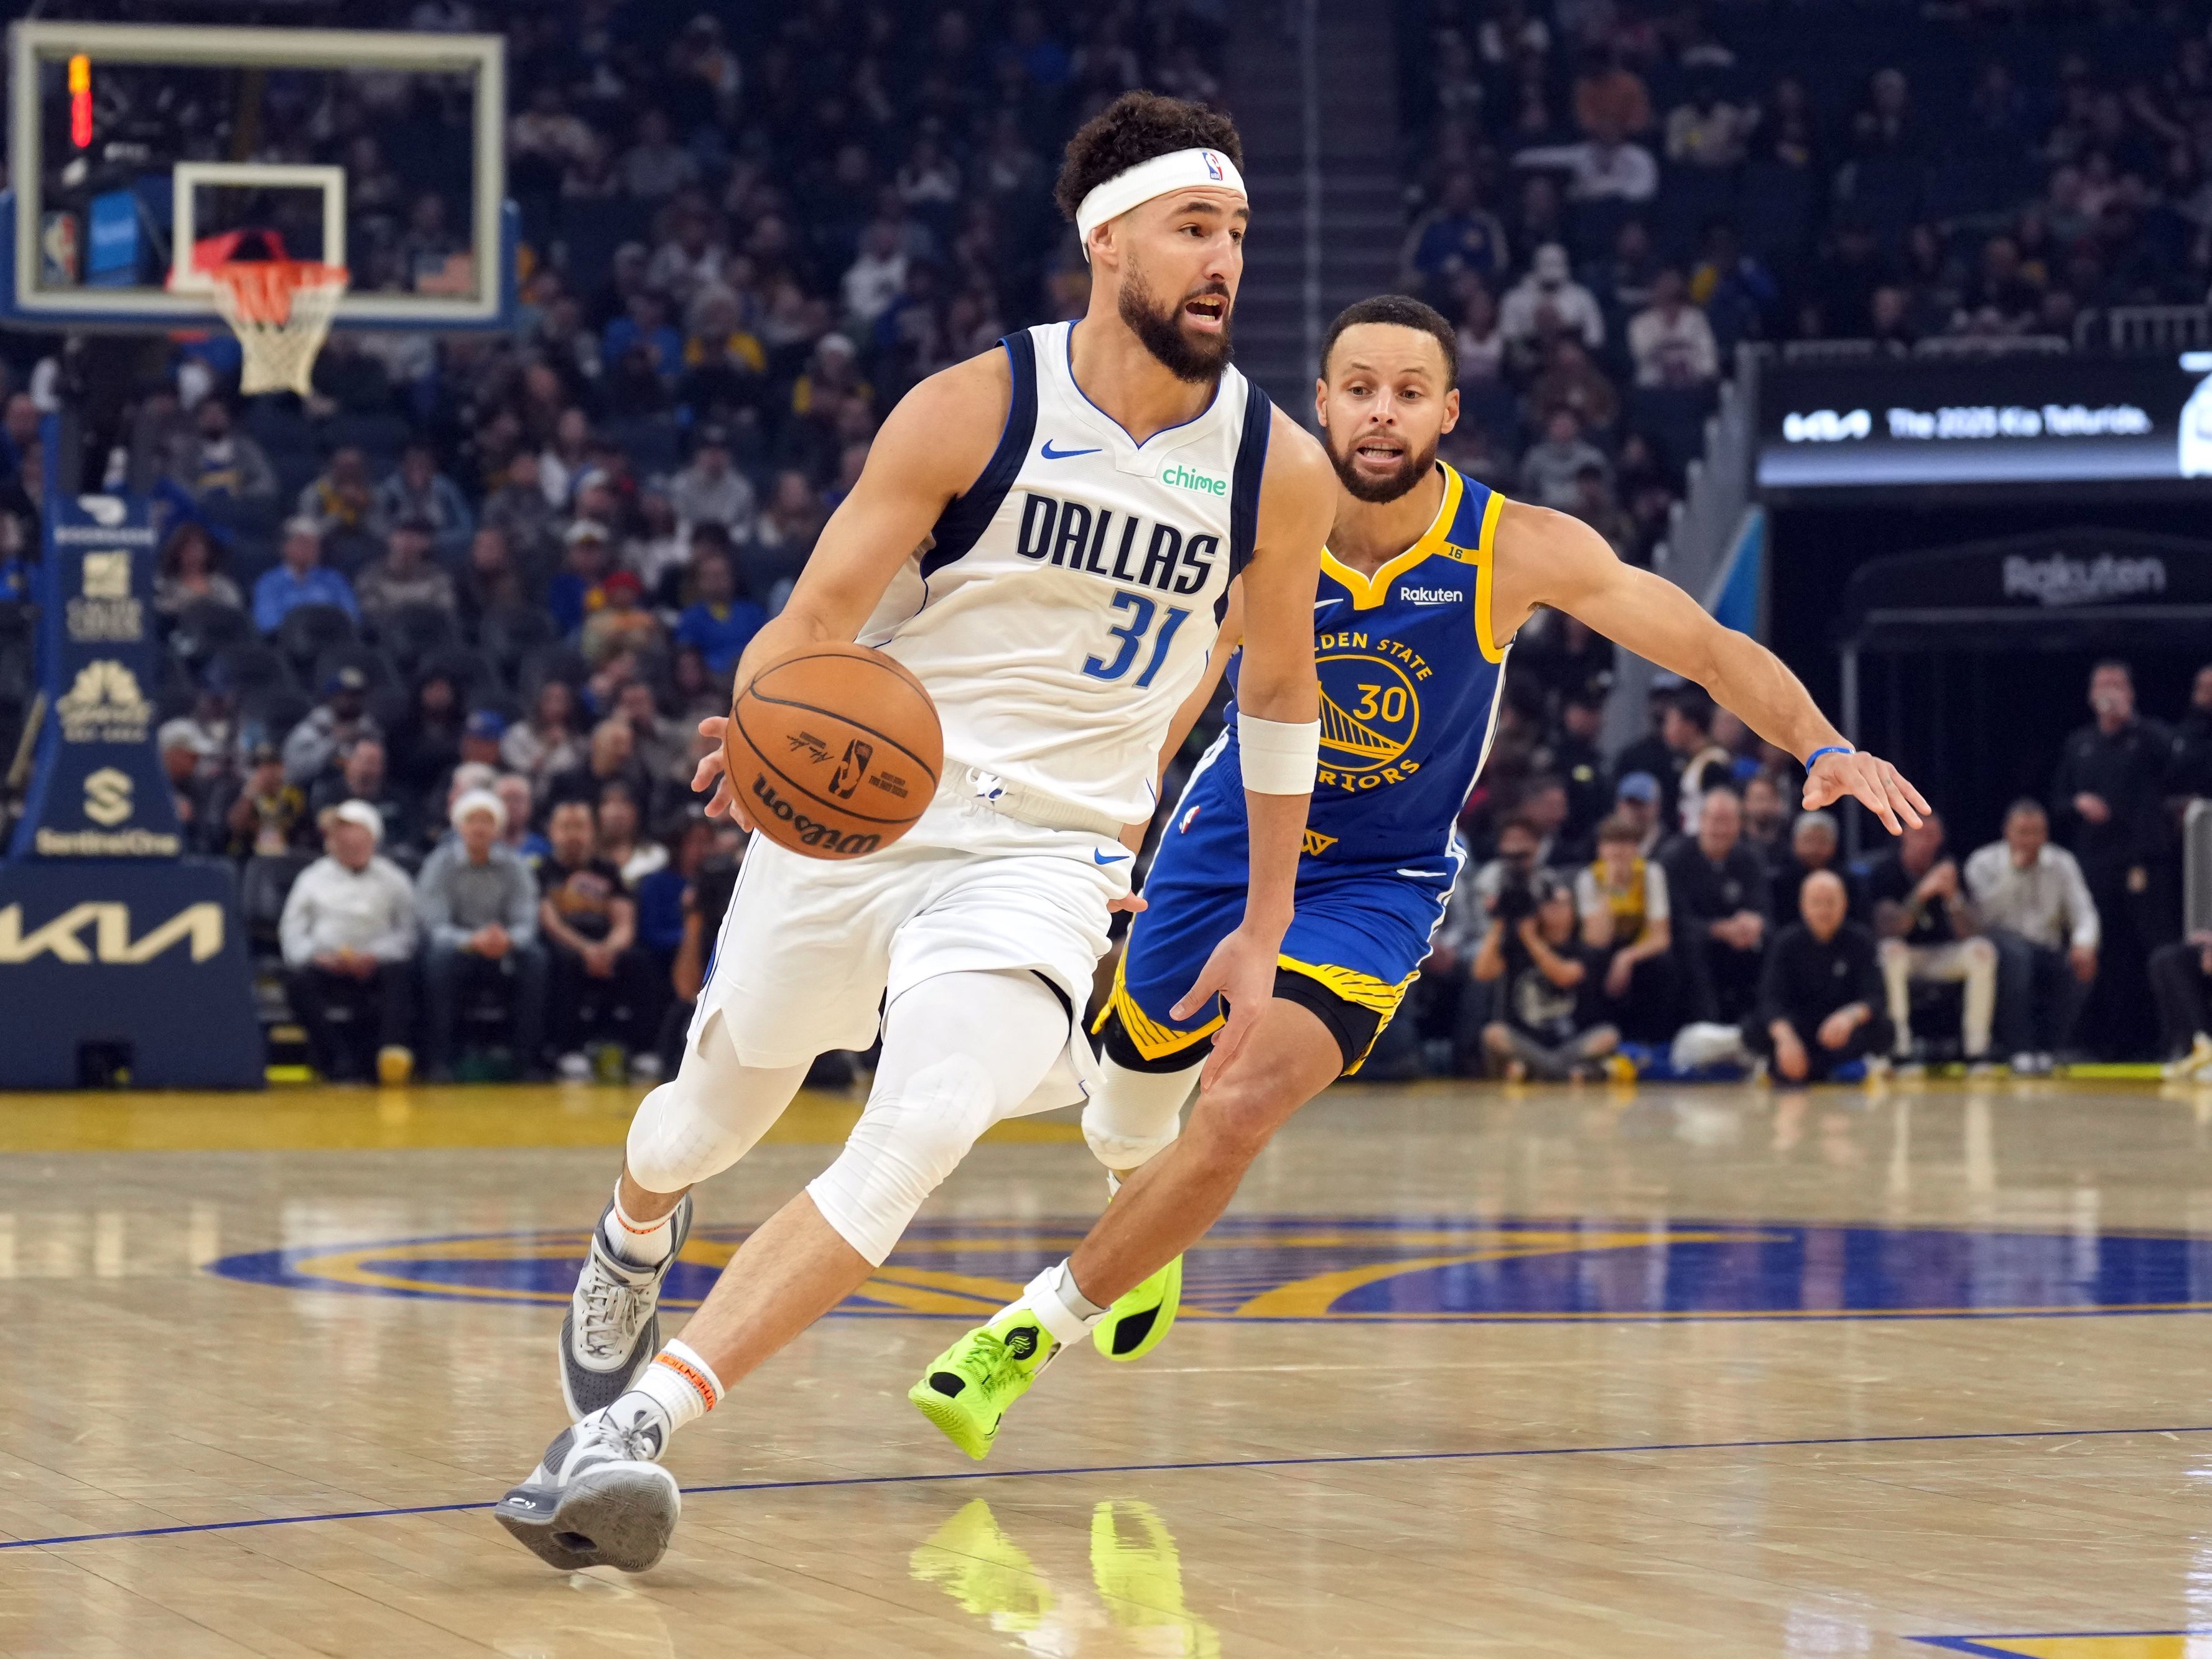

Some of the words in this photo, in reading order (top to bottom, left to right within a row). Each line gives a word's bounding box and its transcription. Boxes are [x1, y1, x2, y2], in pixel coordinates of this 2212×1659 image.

[1887, 408, 1936, 439] The
[1163, 465, 1226, 496] chime
[1015, 491, 1222, 597] DALLAS
[1448, 546, 1463, 559] 16
[1401, 587, 1463, 604] Rakuten
[2003, 554, 2165, 605] Rakuten
[1080, 588, 1193, 690] 31
[1314, 633, 1368, 652] DEN
[1377, 639, 1433, 682] STATE
[1353, 684, 1408, 723] 30
[1317, 759, 1420, 793] RIORS
[751, 772, 883, 854] Wilson
